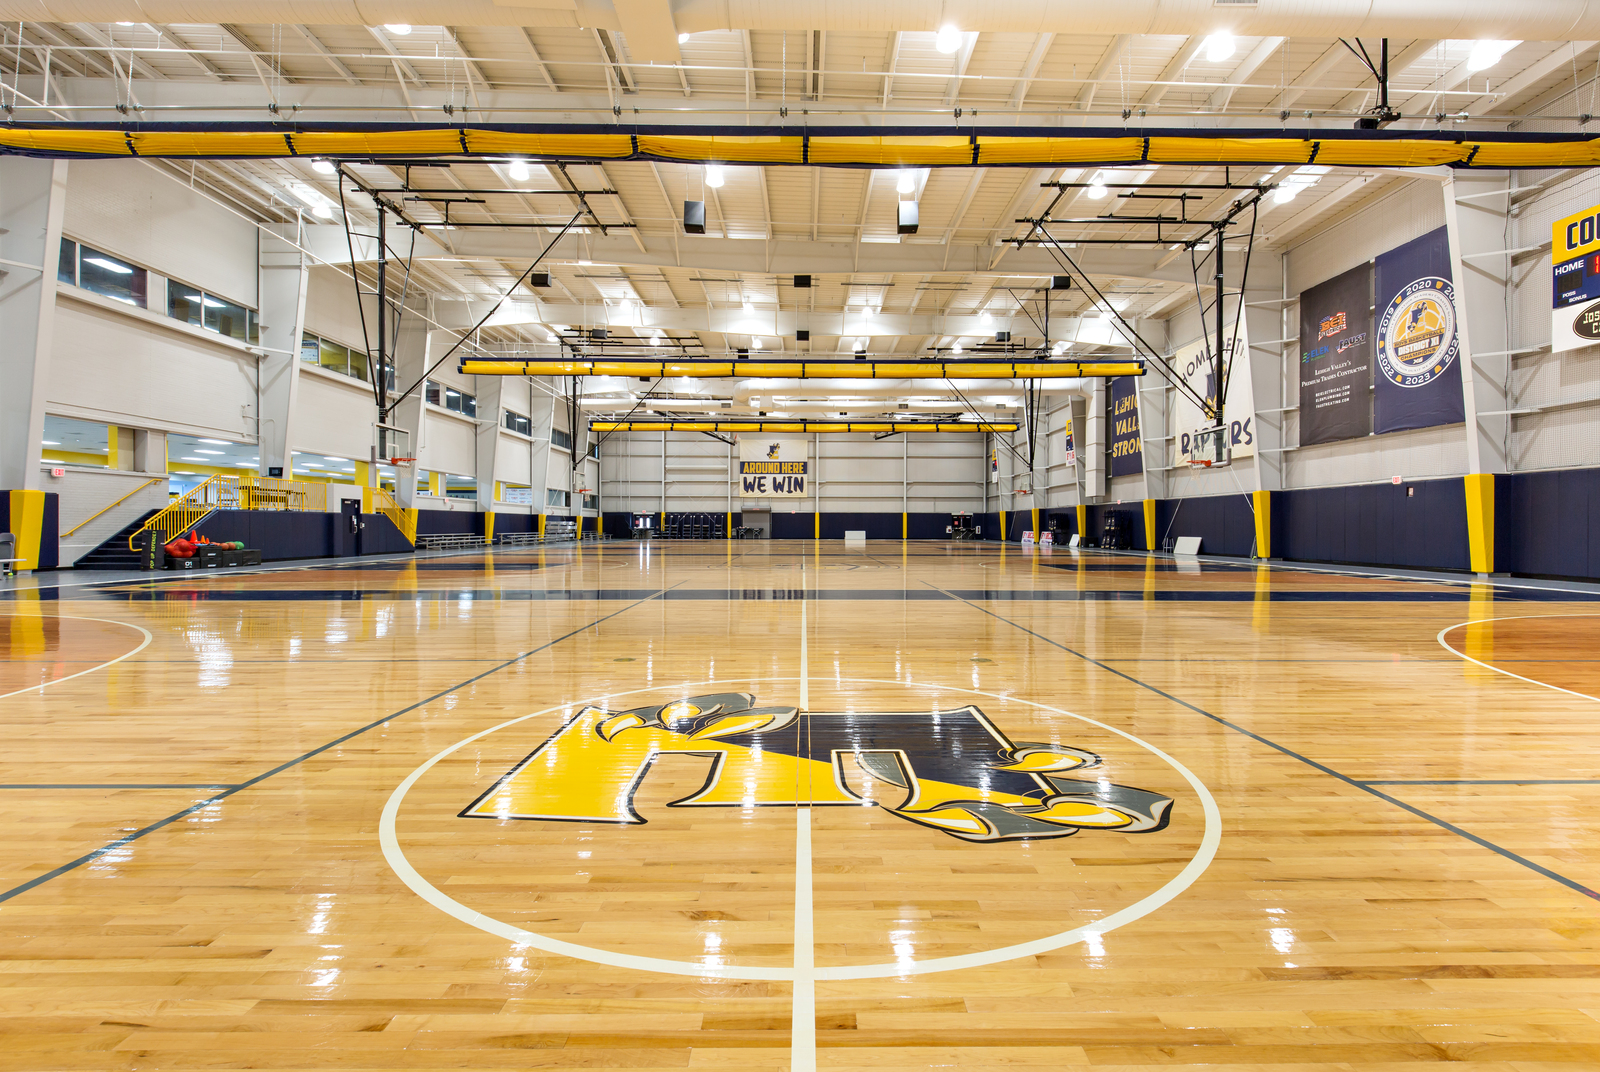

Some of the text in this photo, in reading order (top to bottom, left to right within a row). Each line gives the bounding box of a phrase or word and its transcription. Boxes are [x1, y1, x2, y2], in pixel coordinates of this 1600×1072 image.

[1566, 212, 1600, 251] CO
[1555, 260, 1584, 276] HOME
[1562, 290, 1576, 298] POSS
[1568, 294, 1587, 302] BONUS
[1381, 307, 1395, 334] 2019
[1406, 280, 1432, 296] 2020
[1320, 314, 1344, 332] BEI
[1339, 332, 1366, 349] FAUST
[1409, 330, 1443, 342] BASKETBALL
[1310, 345, 1329, 358] ELEK
[1398, 336, 1440, 356] DISTRICT XI
[1400, 348, 1436, 360] CHAMPIONS
[1302, 379, 1320, 387] PREMIUM
[1337, 365, 1367, 378] CONTRACTOR
[1315, 367, 1330, 376] LEHIGH
[1380, 352, 1394, 376] 2022
[1406, 372, 1430, 384] 2023
[1116, 416, 1140, 436] VALL
[1182, 417, 1252, 456] RAPRS
[743, 462, 804, 474] AROUND HERE
[743, 476, 804, 494] WE WIN
